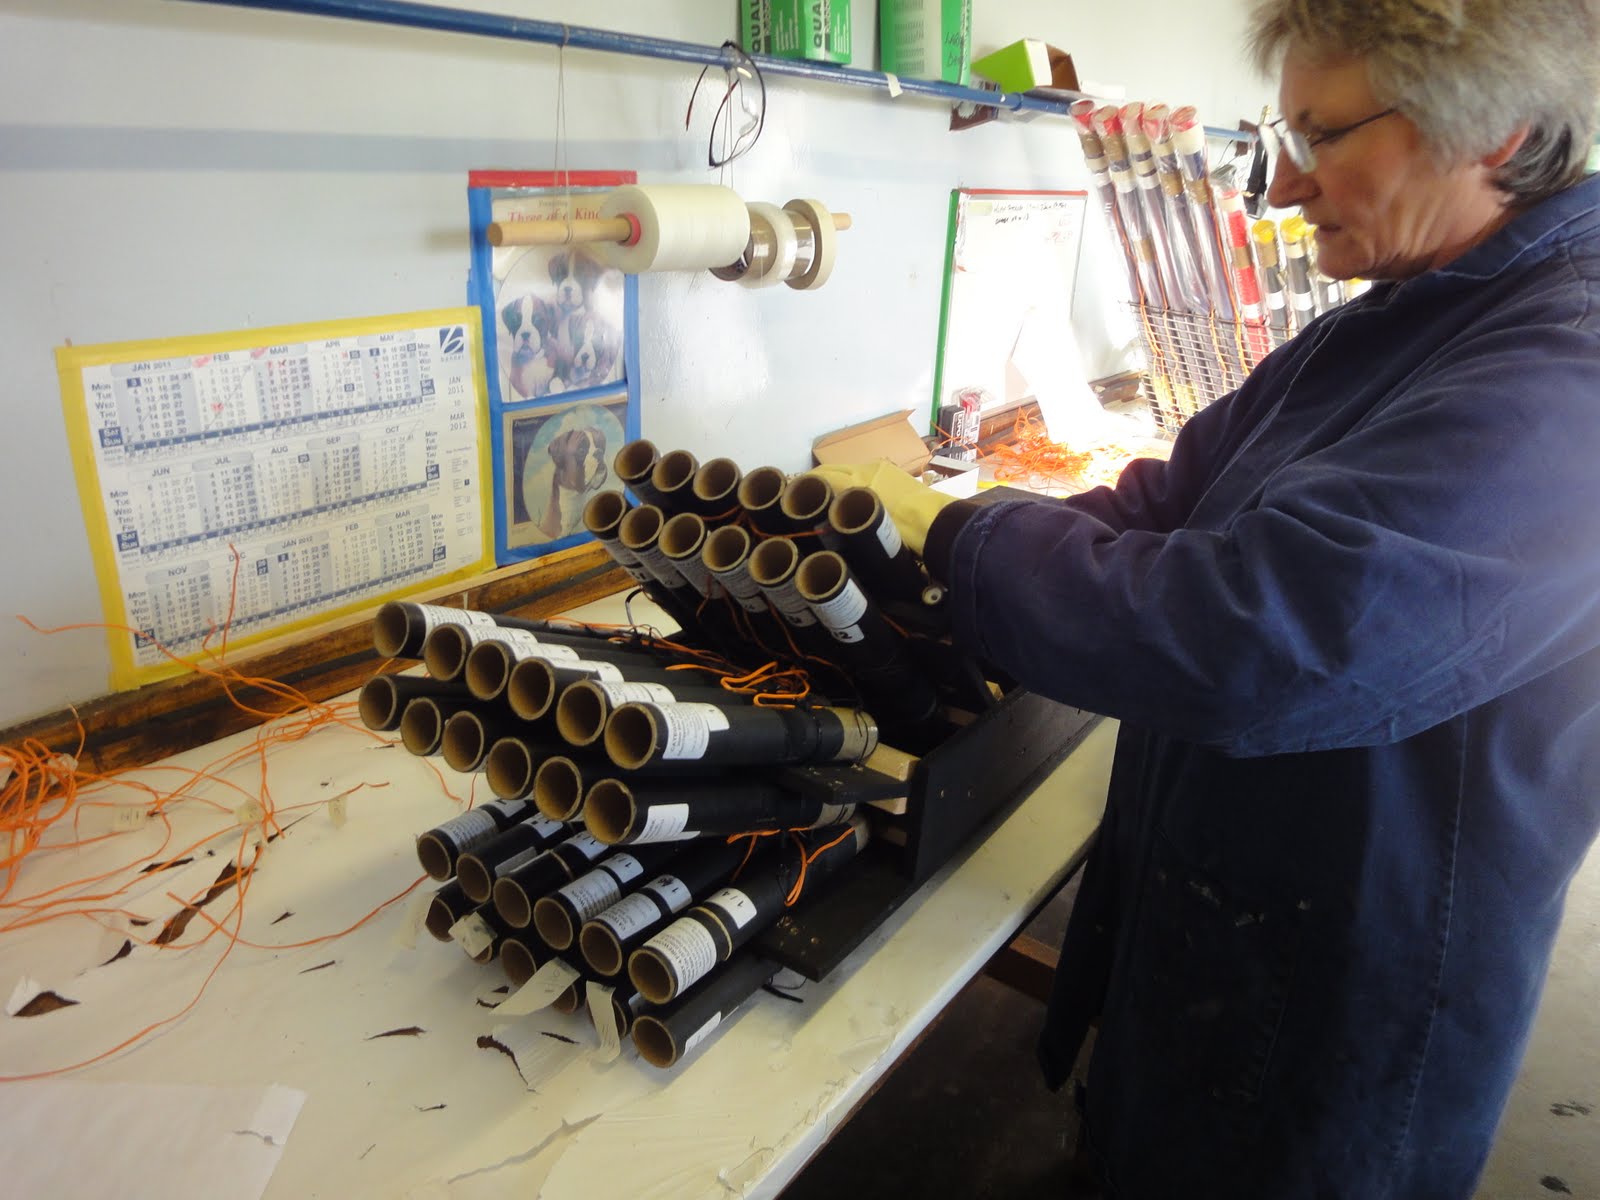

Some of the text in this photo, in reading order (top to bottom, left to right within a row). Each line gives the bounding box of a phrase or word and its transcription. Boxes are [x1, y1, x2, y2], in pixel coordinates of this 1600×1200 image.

[133, 363, 150, 371] JAN
[449, 376, 460, 385] JAN
[448, 385, 464, 394] 2011
[450, 412, 465, 420] MAR
[451, 422, 466, 431] 2012
[271, 446, 288, 454] AUG
[152, 468, 170, 476] JUN
[282, 538, 296, 549] JAN
[229, 552, 246, 561] DC
[168, 566, 187, 576] NOV
